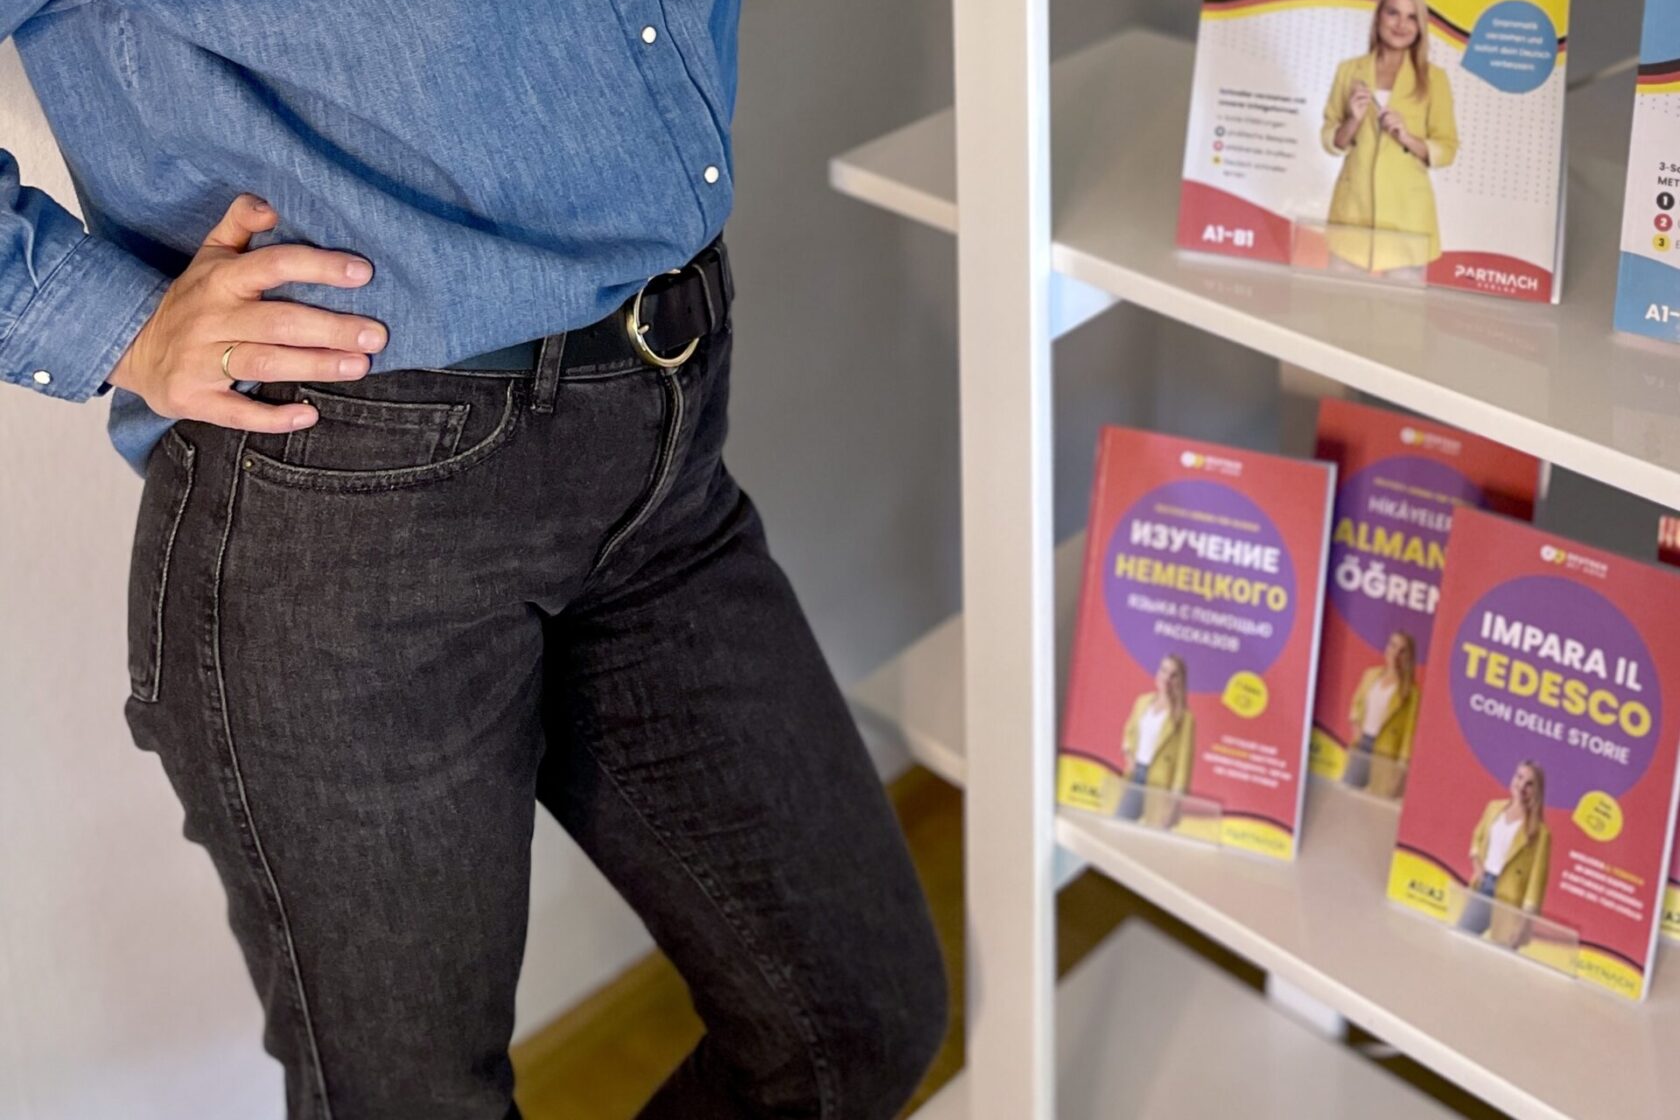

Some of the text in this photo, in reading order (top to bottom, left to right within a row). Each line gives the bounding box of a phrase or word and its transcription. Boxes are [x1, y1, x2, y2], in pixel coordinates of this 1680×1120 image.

[1202, 224, 1254, 248] A1-B1
[1454, 264, 1538, 291] PARTNACH
[1130, 519, 1280, 574] ИЗУЧЕНИЕ
[1115, 552, 1288, 612] НЕМЕЦКОГО
[1480, 610, 1643, 692] IMPARA IL
[1461, 641, 1653, 738] TEDESCO
[1469, 693, 1631, 765] CON DELLE STORIE
